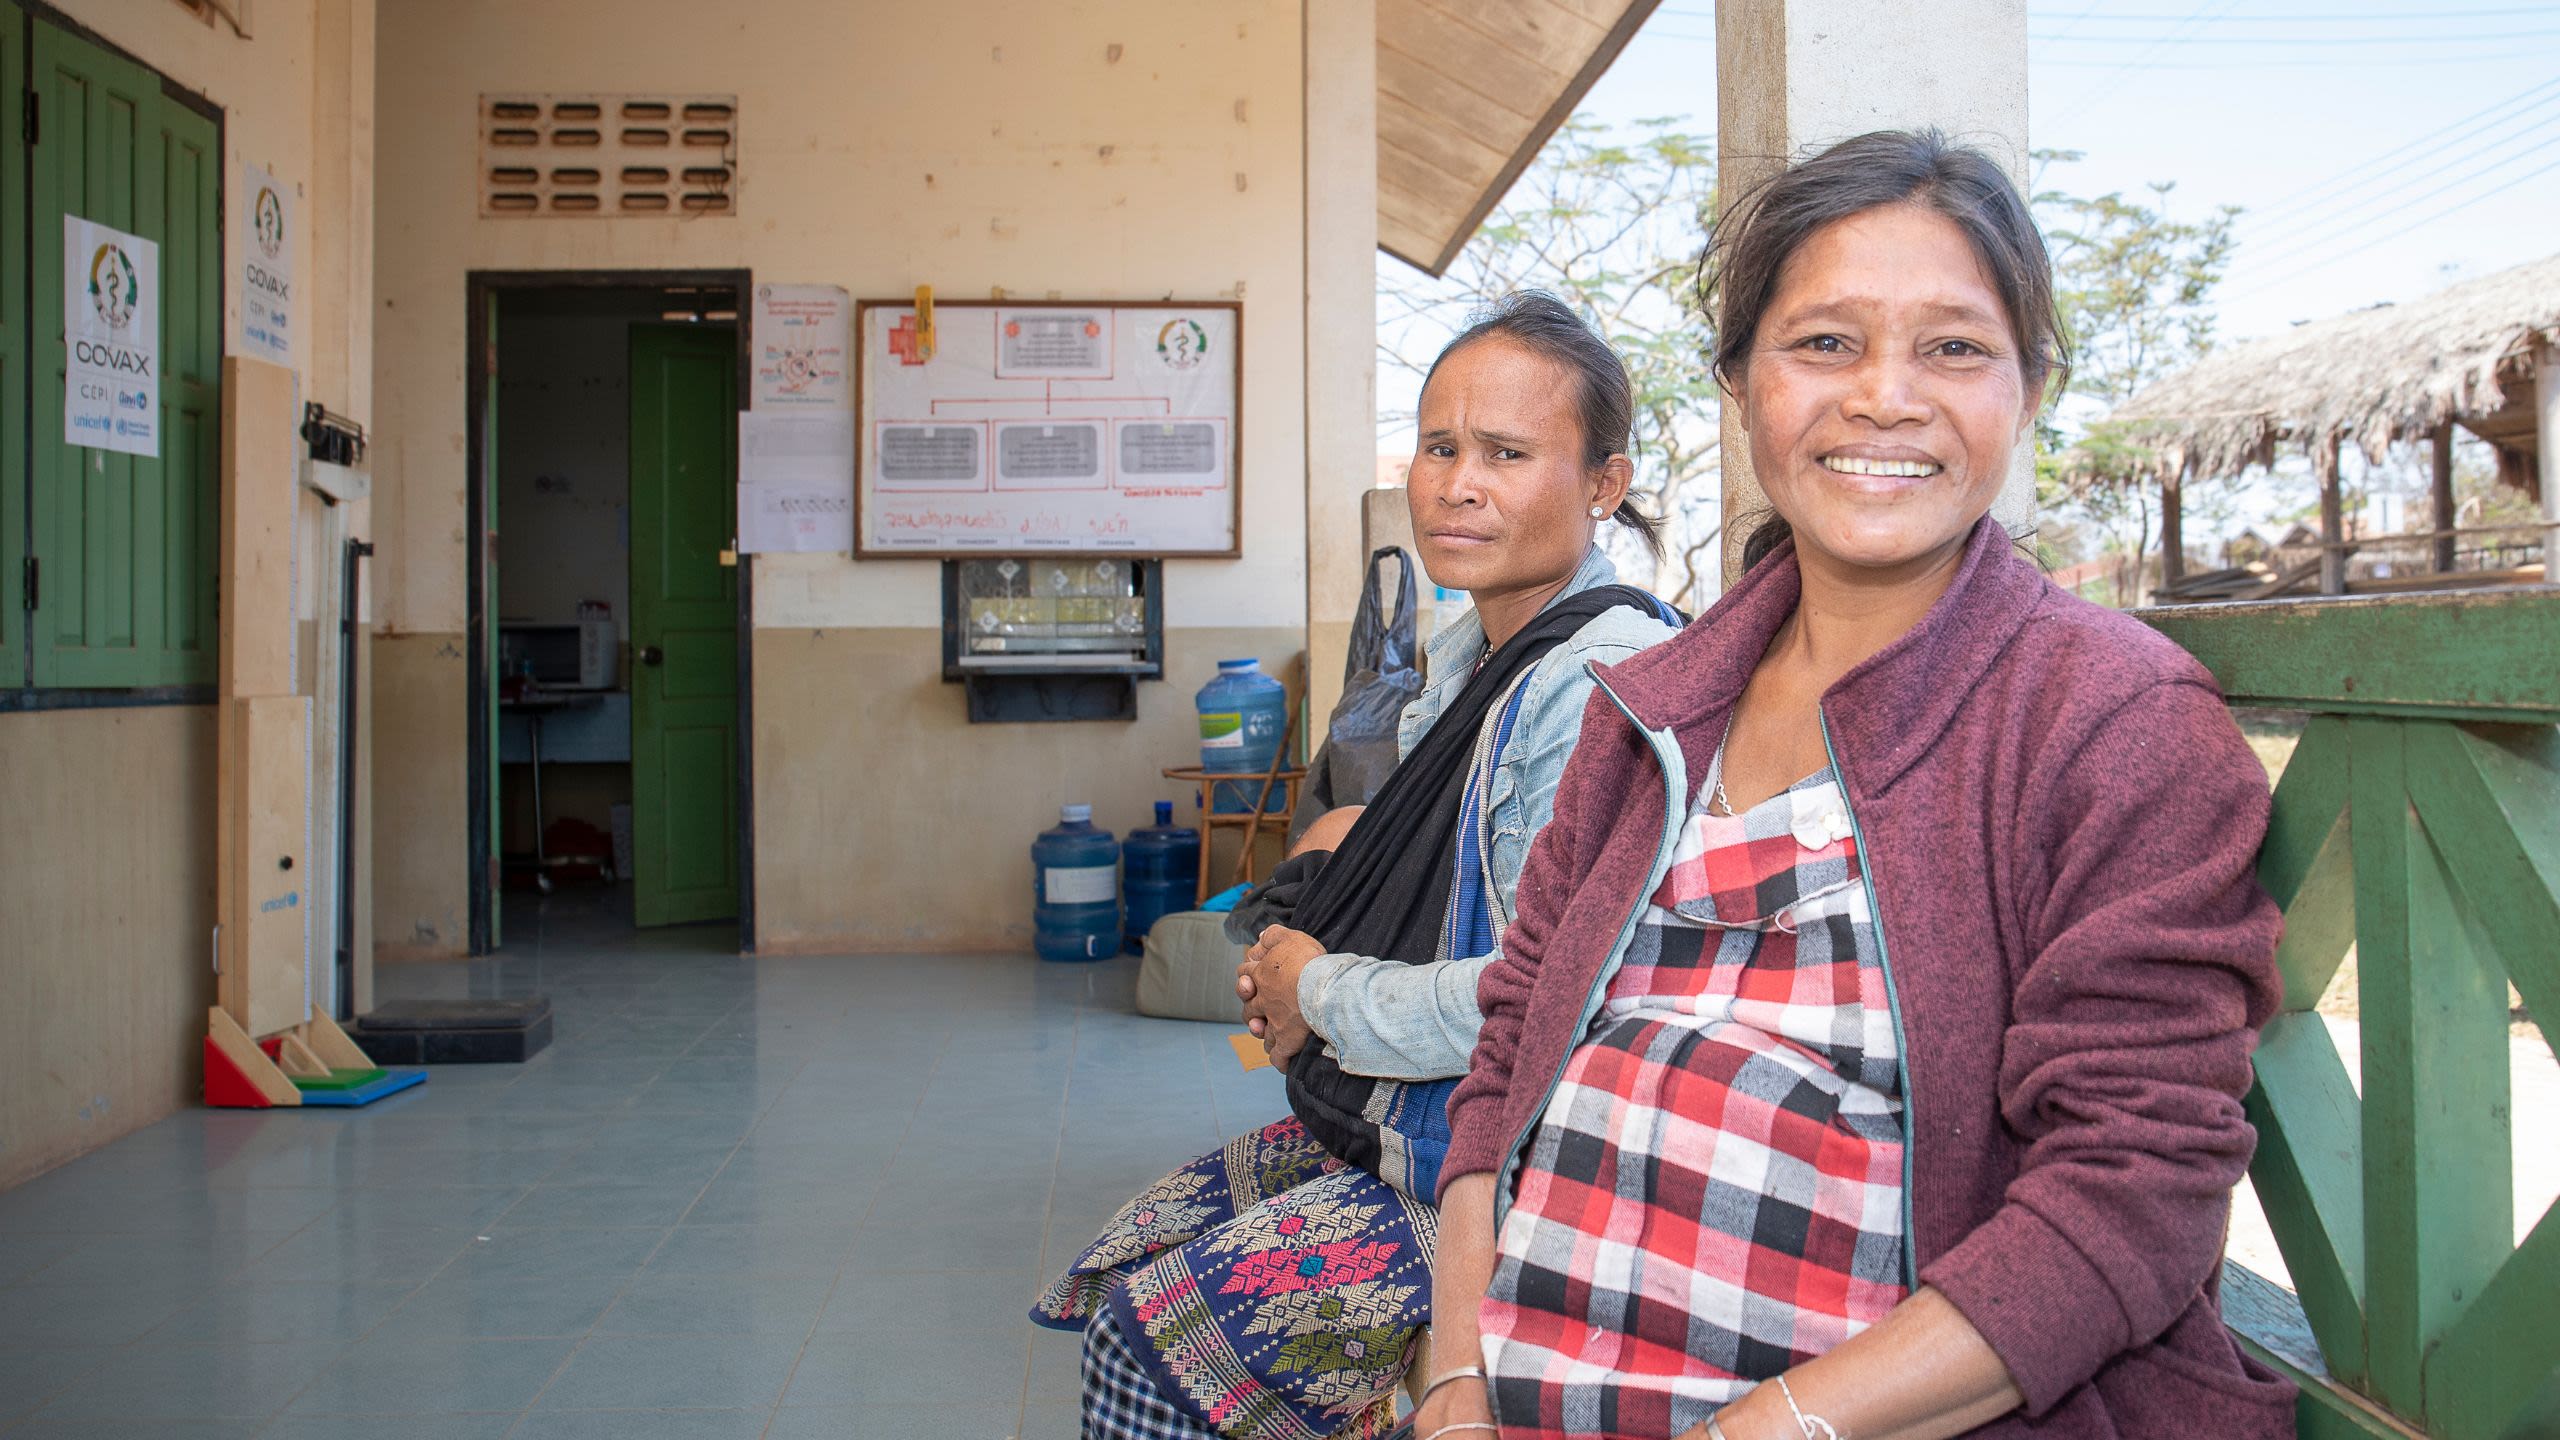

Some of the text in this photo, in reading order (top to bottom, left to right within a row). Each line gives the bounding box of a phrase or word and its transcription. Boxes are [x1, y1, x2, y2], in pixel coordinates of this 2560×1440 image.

[246, 263, 288, 301] COVAX
[76, 341, 149, 376] COVAX
[80, 383, 108, 401] CEPI
